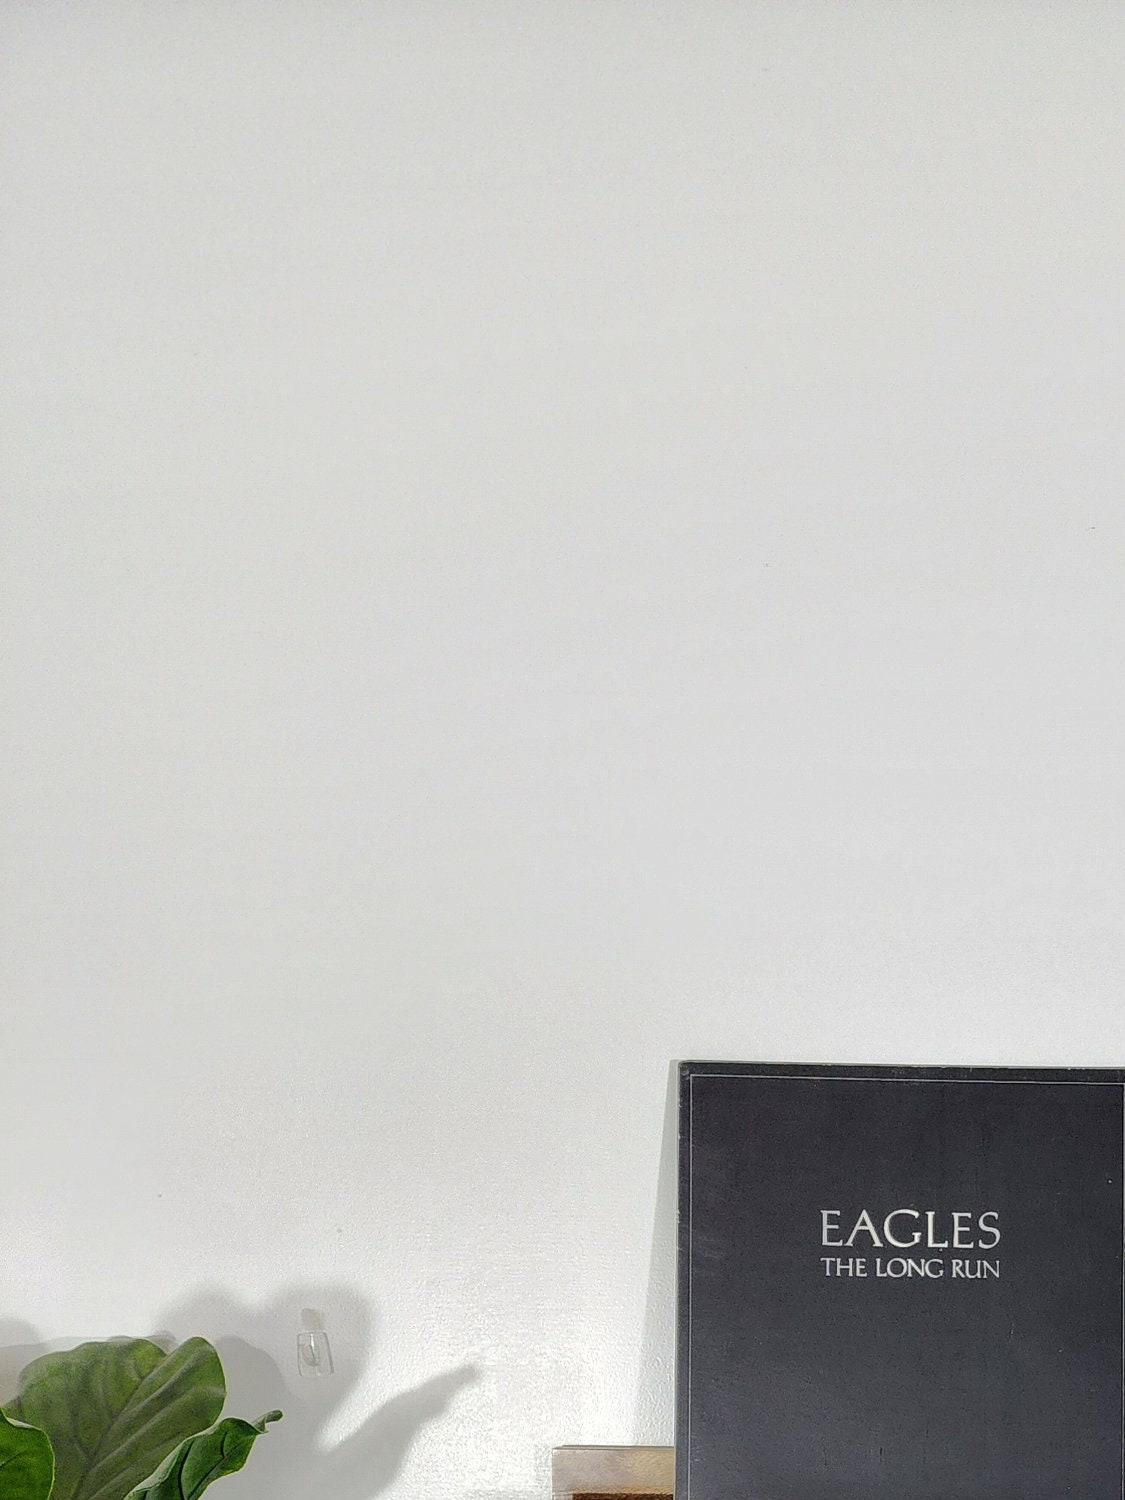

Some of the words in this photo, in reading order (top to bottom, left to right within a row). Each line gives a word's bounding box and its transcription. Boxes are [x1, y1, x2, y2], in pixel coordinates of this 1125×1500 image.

[821, 1209, 1000, 1249] EAGLES
[821, 1258, 867, 1276] THE
[876, 1258, 943, 1278] LONG
[952, 1259, 999, 1278] RUN
